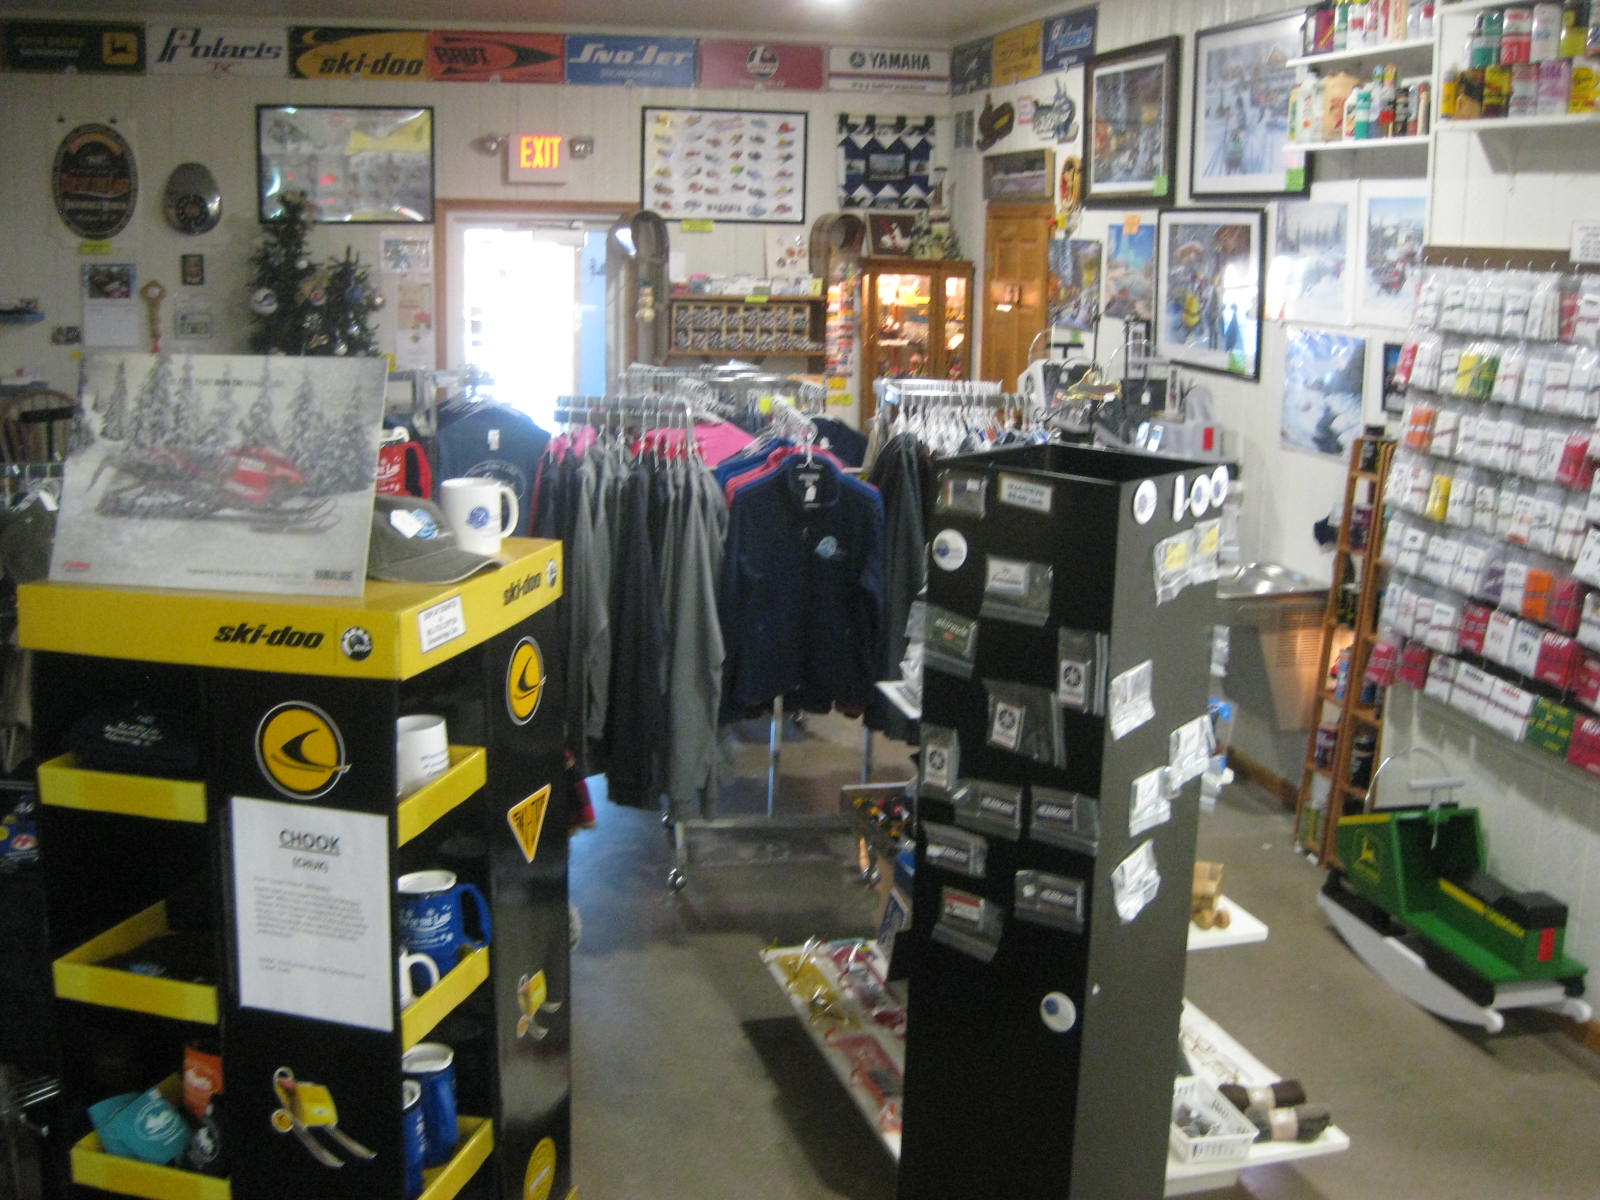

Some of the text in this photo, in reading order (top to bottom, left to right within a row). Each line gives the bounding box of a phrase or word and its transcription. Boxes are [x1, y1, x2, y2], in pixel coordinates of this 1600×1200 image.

[156, 28, 283, 62] Polaris
[319, 52, 424, 76] ski-doo
[870, 53, 931, 71] YAMAHA
[520, 135, 562, 168] EXIT
[503, 572, 542, 607] ski-doo
[214, 623, 325, 649] ski-doo
[279, 829, 341, 855] CHOOK
